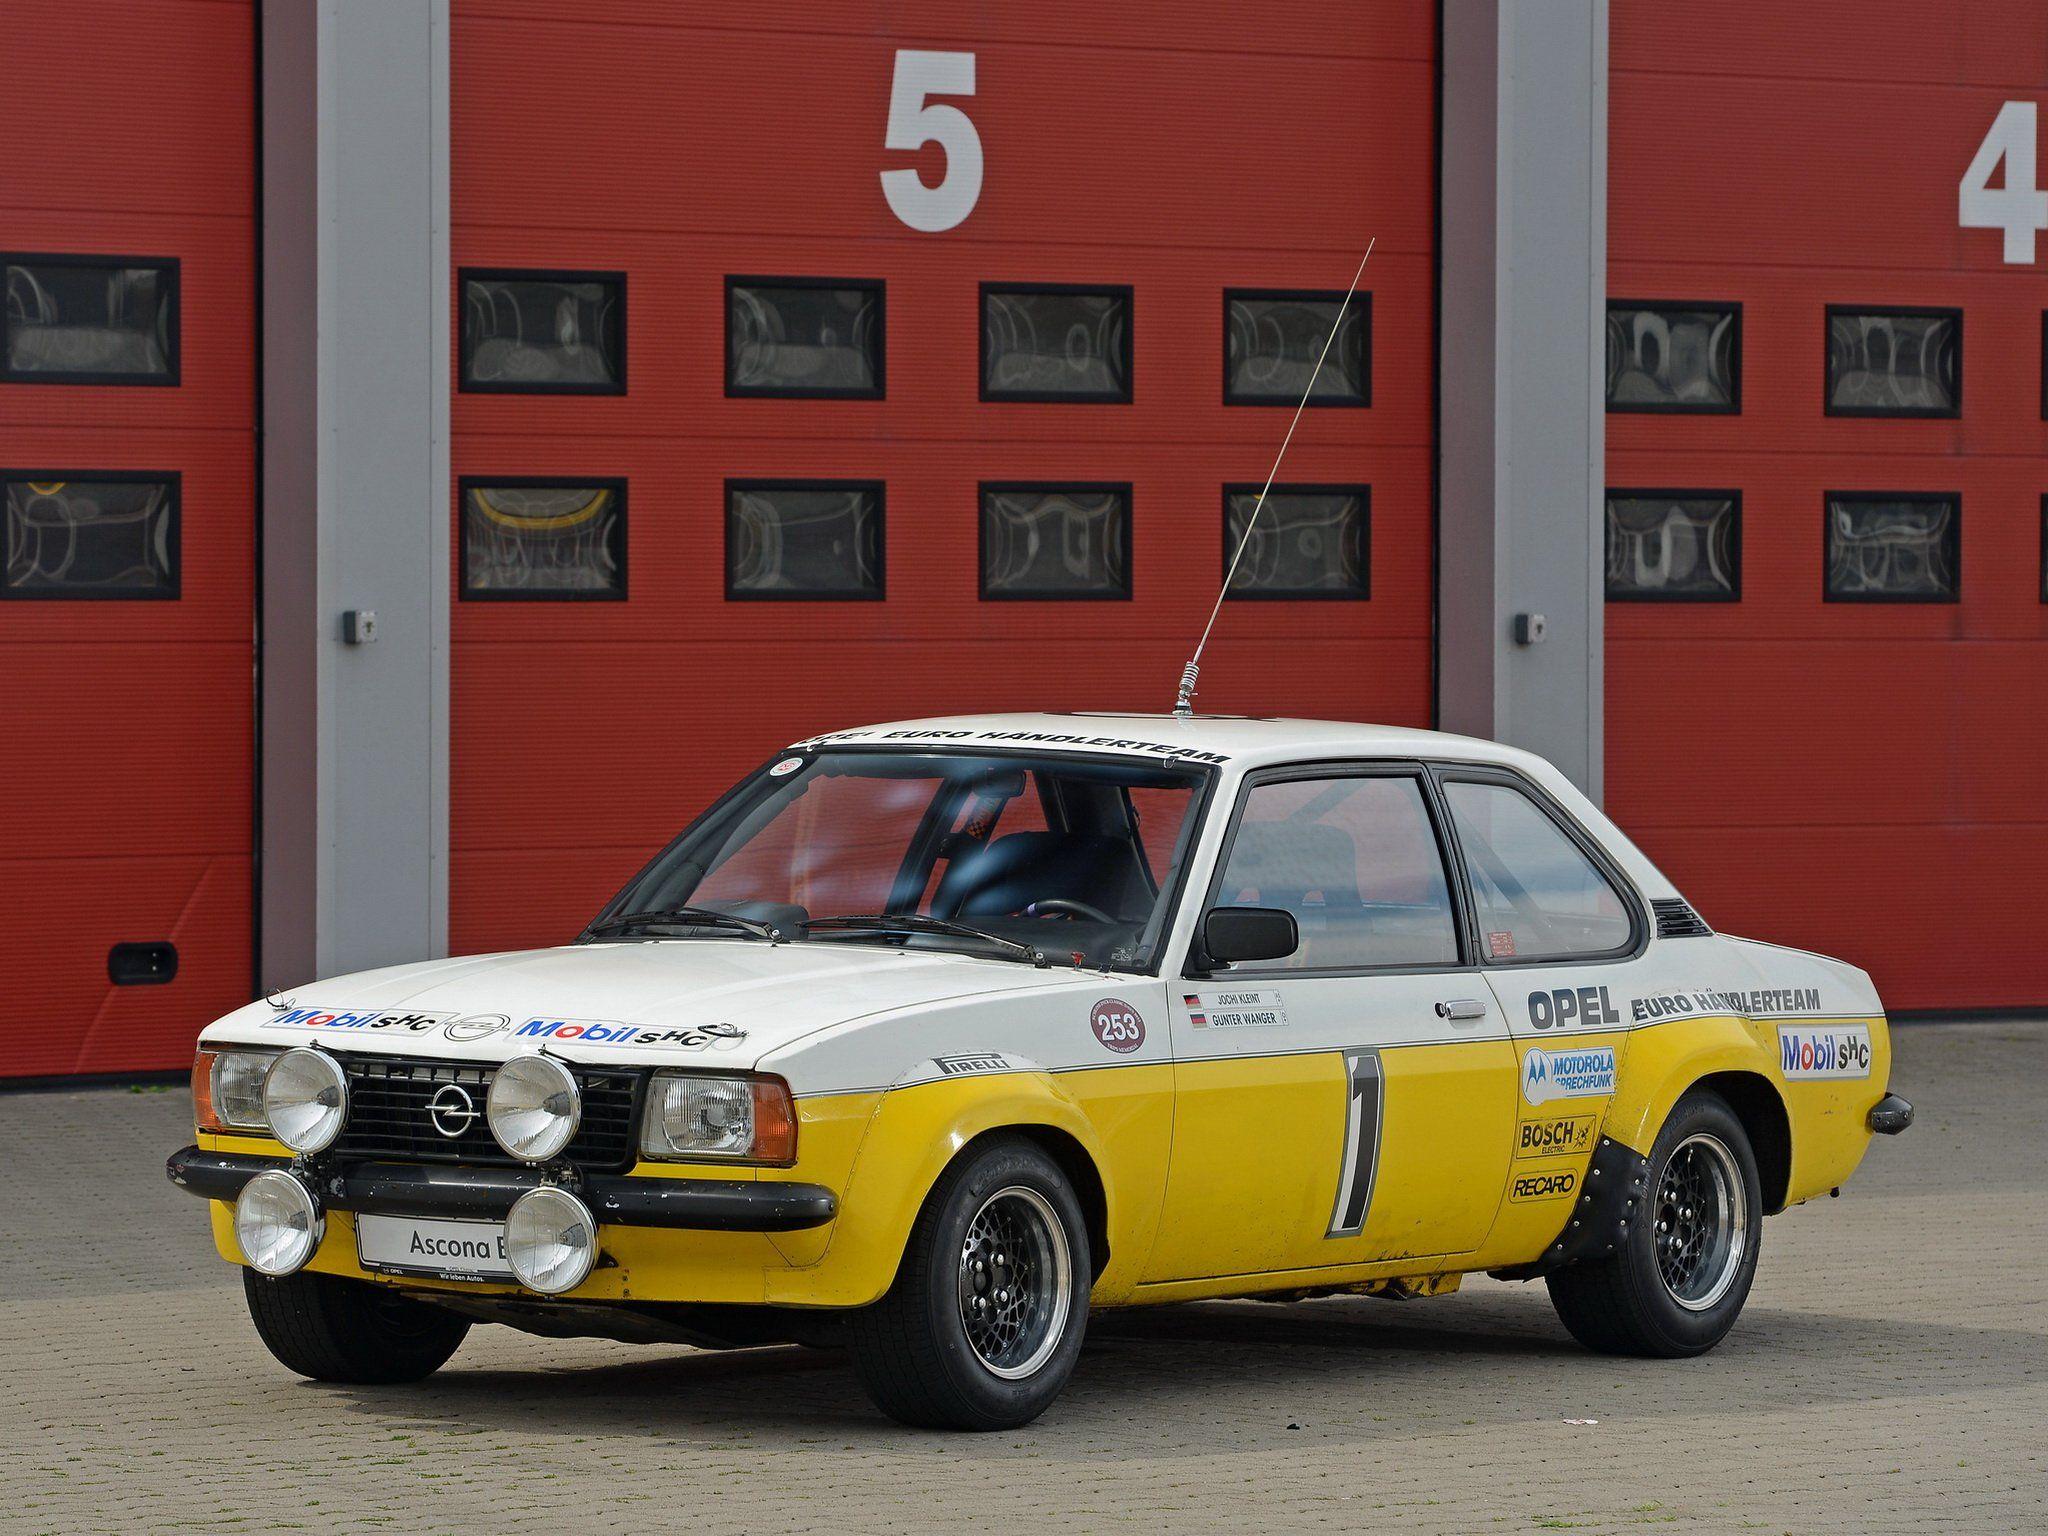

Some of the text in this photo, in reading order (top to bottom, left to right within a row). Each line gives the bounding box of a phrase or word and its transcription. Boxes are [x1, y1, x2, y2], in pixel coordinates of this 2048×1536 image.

[879, 49, 984, 233] 5
[1958, 100, 2048, 264] 4
[881, 730, 974, 739] EURO
[976, 730, 1233, 764] HÄNDLERTEAM
[1217, 994, 1239, 1006] JOCHI
[1240, 993, 1261, 1005] KLEINT
[1527, 985, 1822, 1030] OPEL EURO HÄNDLERTEAM
[274, 1009, 379, 1028] Mobil
[515, 1020, 641, 1042] Mobil
[1098, 1013, 1140, 1041] 253
[1212, 1013, 1242, 1027] GUNTER
[1243, 1012, 1277, 1025] WANGER
[930, 1053, 1011, 1075] PIRELLI
[1553, 1053, 1614, 1075] MOTOROLA
[1782, 1035, 1836, 1070] Mobil
[1336, 1054, 1381, 1232] 1
[1521, 1121, 1574, 1148] BOSCH
[1541, 1145, 1565, 1154] ELECTRIC
[1513, 1173, 1575, 1197] RECARO
[410, 1230, 491, 1259] Ascona
